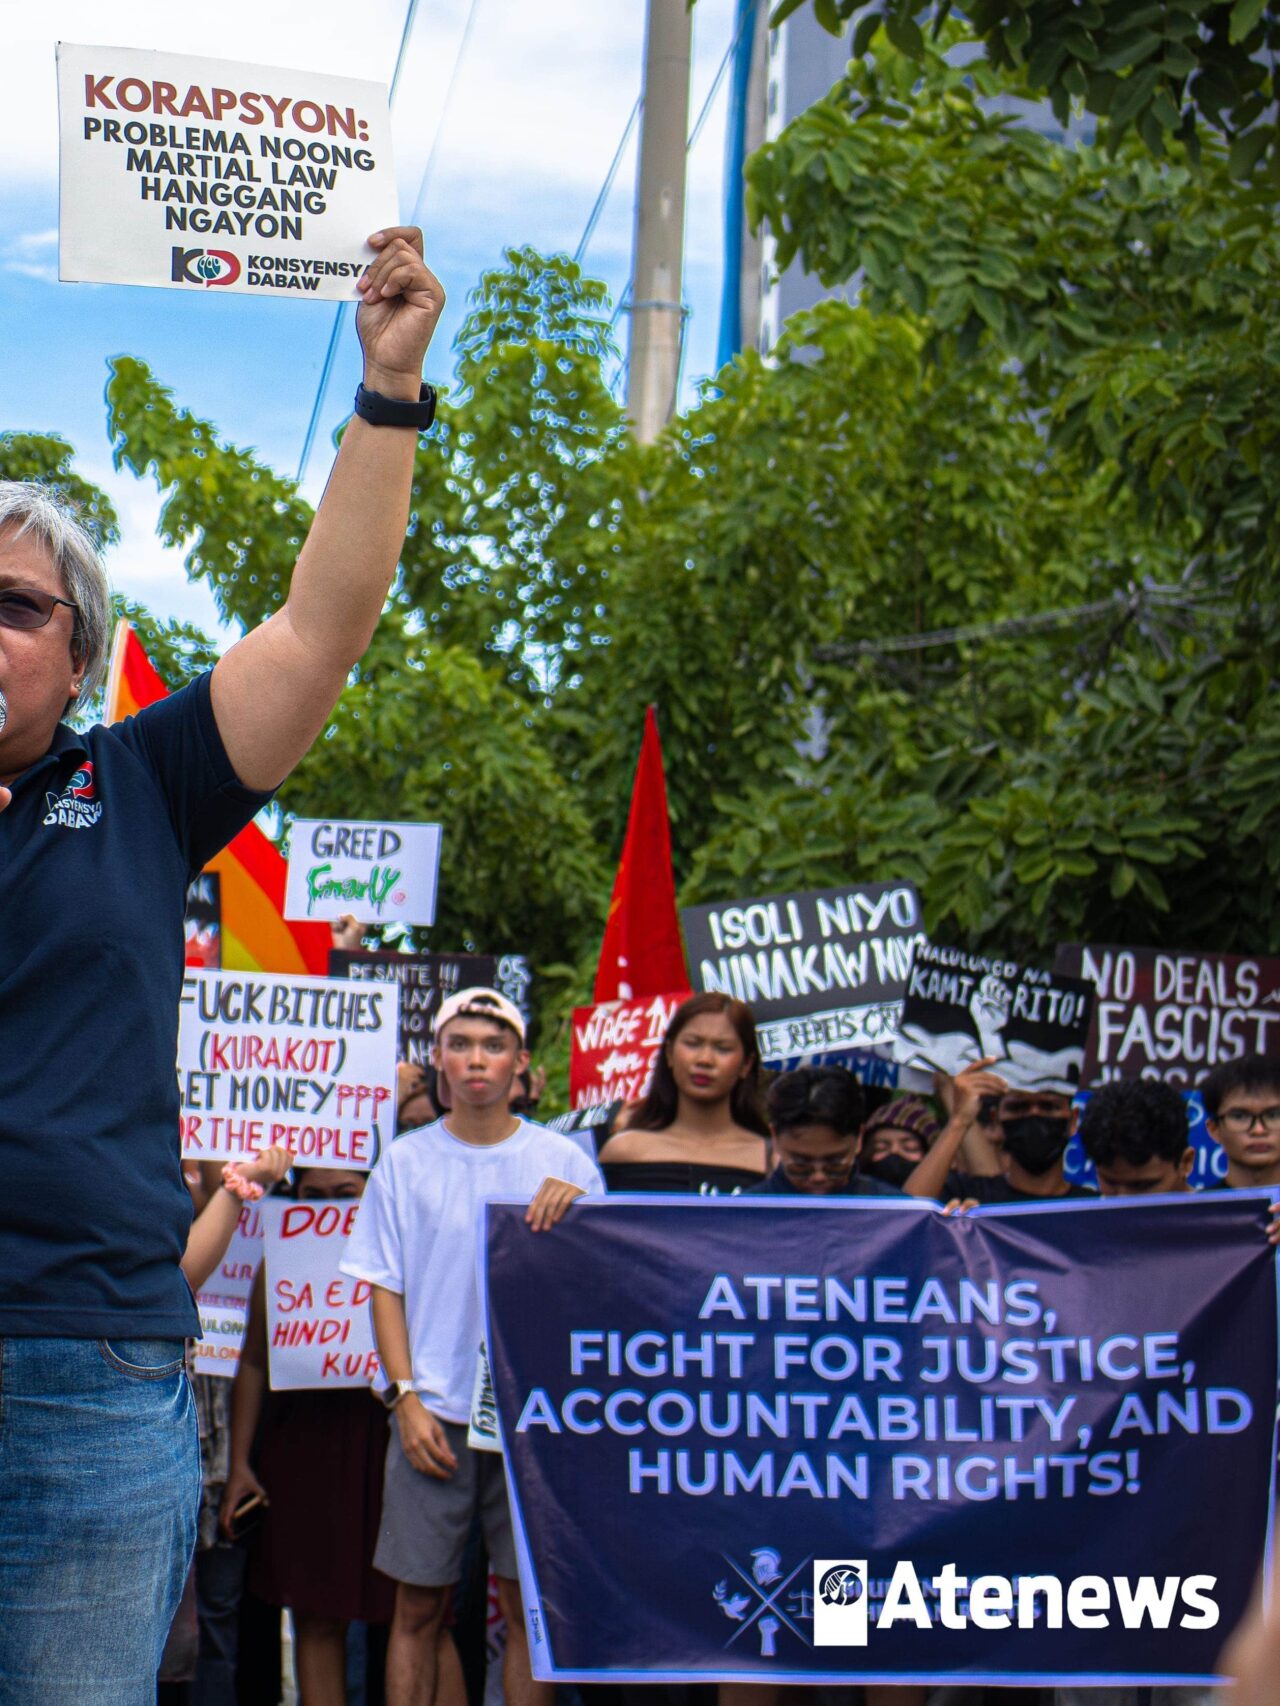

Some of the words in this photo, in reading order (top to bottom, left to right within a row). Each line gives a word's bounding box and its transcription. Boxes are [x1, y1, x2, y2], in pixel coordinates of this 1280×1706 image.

[84, 73, 370, 142] KORAPSYON:
[83, 116, 251, 156] PROBLEMA
[260, 135, 376, 172] NOONG
[125, 147, 261, 183] MARTIAL
[271, 163, 338, 191] LAW
[140, 176, 327, 215] HANGGANG
[165, 205, 303, 241] NGAYON
[247, 271, 321, 292] DABAW
[311, 824, 402, 861] GREED
[707, 898, 805, 950] ISOLI
[816, 887, 917, 938] NIYO
[699, 940, 869, 1004] NINAKAW
[908, 964, 975, 1008] KAMI
[1022, 966, 1053, 987] NA
[1080, 947, 1136, 1001] NO
[1153, 953, 1260, 1008] DEALS
[268, 983, 383, 1032] BITCHES
[198, 1030, 347, 1076] (KURAKOT)
[179, 1070, 221, 1111] ET
[207, 1117, 265, 1153] THE
[697, 1275, 1057, 1332] ATENEANS,
[272, 1318, 352, 1348] HINDI
[568, 1330, 756, 1380] FIGHT
[773, 1331, 903, 1383] FOR
[919, 1331, 1196, 1386] JUSTICE,
[515, 1387, 1092, 1449] ACCOUNTABILITY,
[1109, 1387, 1255, 1438] AND
[627, 1447, 870, 1501] HUMAN
[891, 1449, 1141, 1502] RIGHTS!
